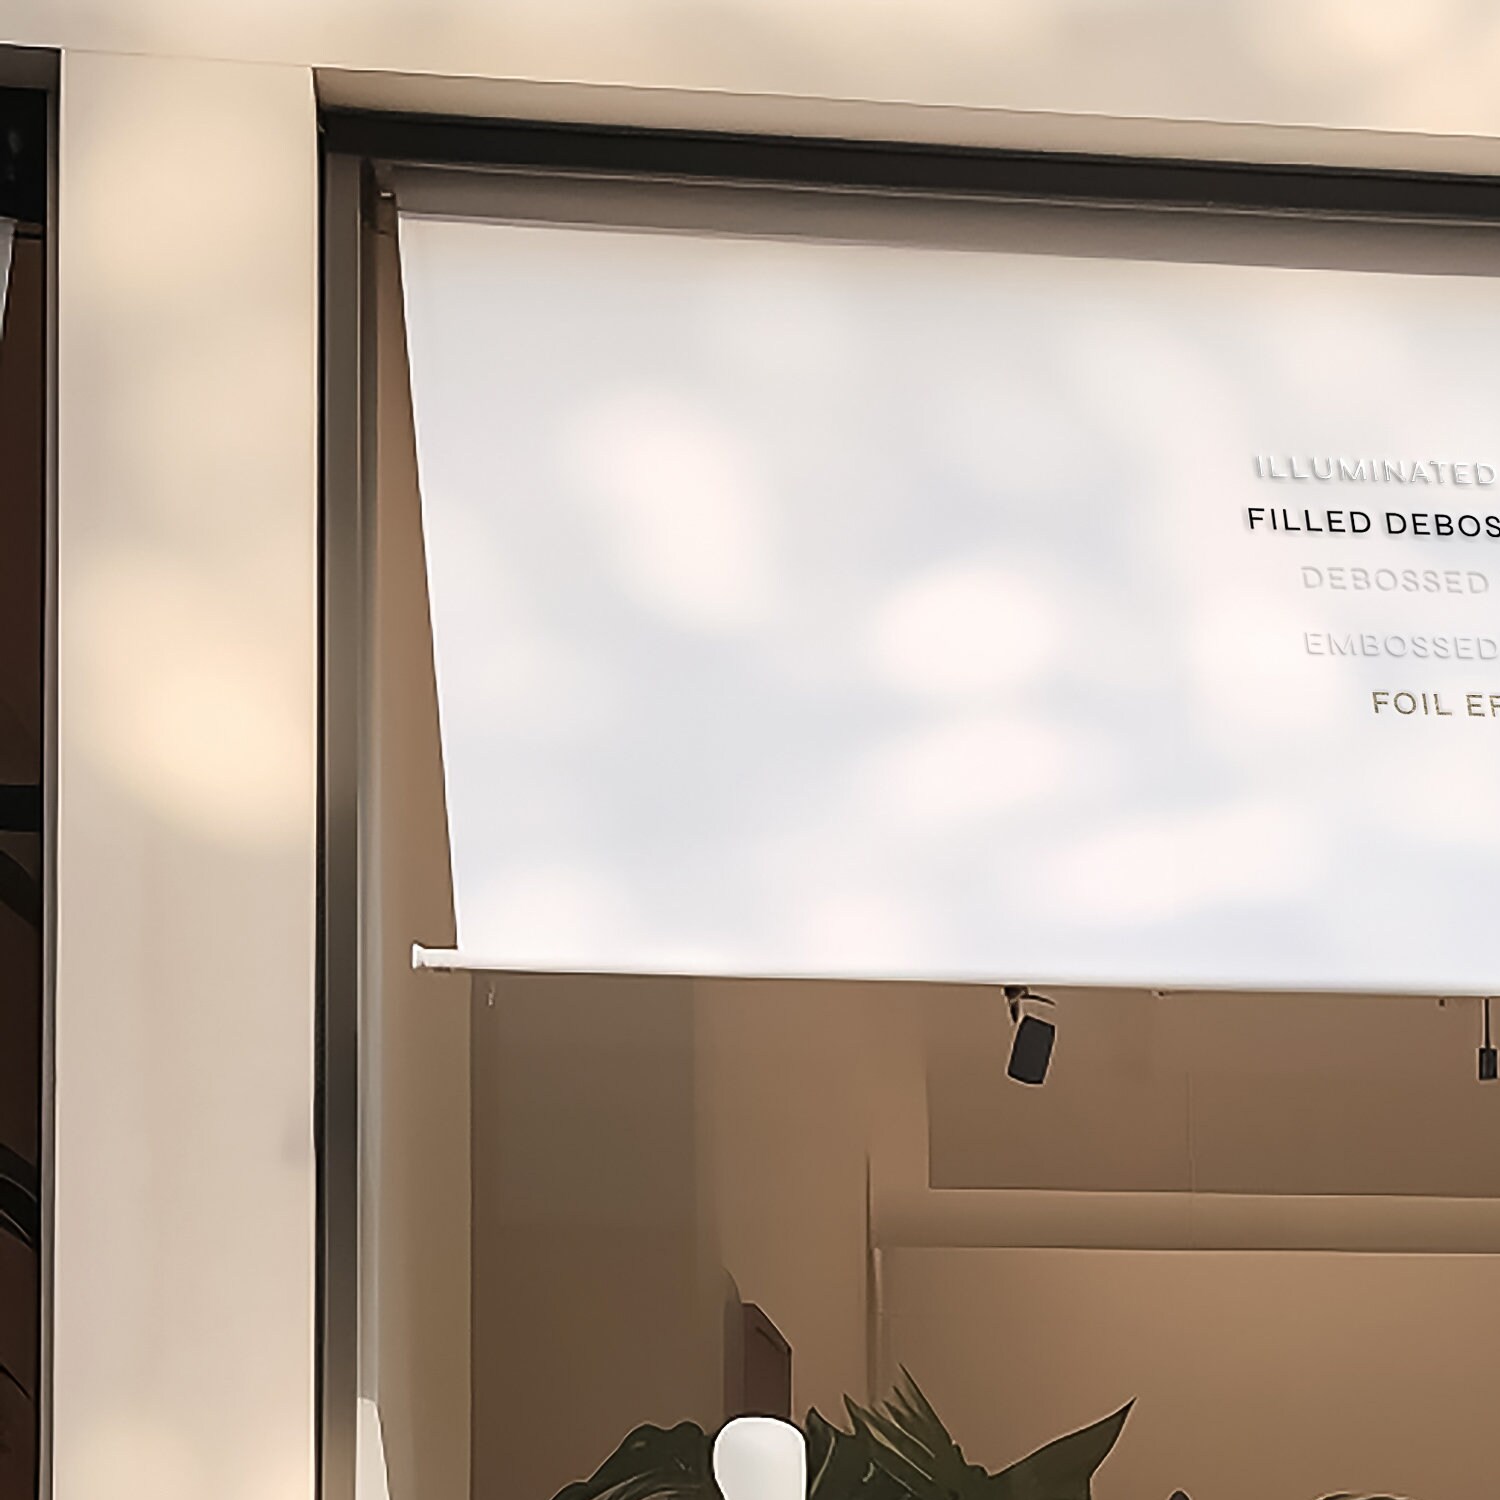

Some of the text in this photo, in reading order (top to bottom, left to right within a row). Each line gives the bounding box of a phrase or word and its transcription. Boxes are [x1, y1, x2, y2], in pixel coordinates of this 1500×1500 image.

[1254, 455, 1496, 485] ILLUMINATED
[1248, 507, 1372, 534] FILLED
[1300, 566, 1490, 594] DEBOSSED
[1304, 632, 1499, 660] EMBOSSED
[1372, 691, 1453, 716] FOIL
